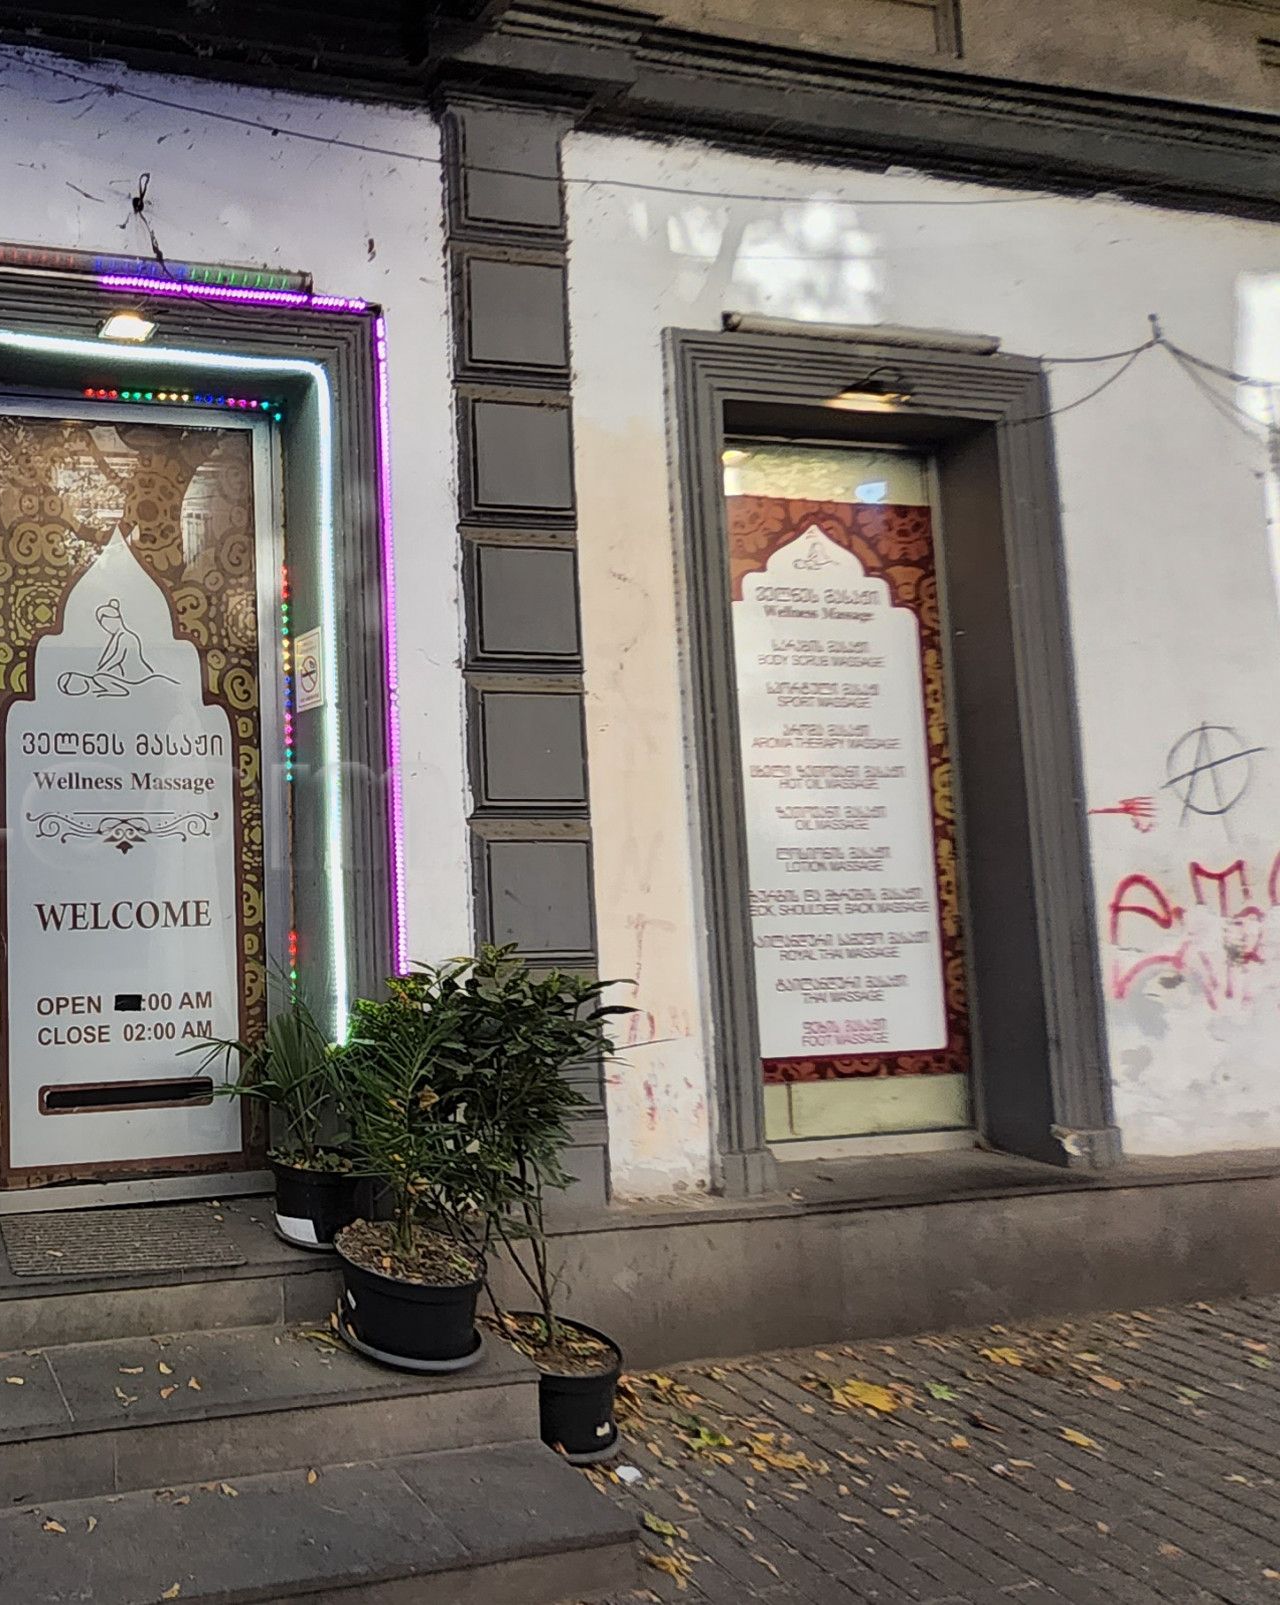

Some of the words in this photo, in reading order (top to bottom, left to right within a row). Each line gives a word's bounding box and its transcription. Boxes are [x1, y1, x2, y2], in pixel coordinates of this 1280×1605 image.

[763, 605, 819, 618] Wellness
[22, 732, 125, 755] ველნეს
[136, 733, 223, 756] მასაჟი
[33, 771, 123, 790] Wellness
[130, 773, 216, 794] Massage
[34, 900, 212, 931] WELCOME
[37, 996, 101, 1015] OPEN
[179, 991, 212, 1010] AM
[37, 1025, 111, 1045] CLOSE
[123, 1022, 176, 1042] 02:00
[182, 1020, 212, 1037] AM
